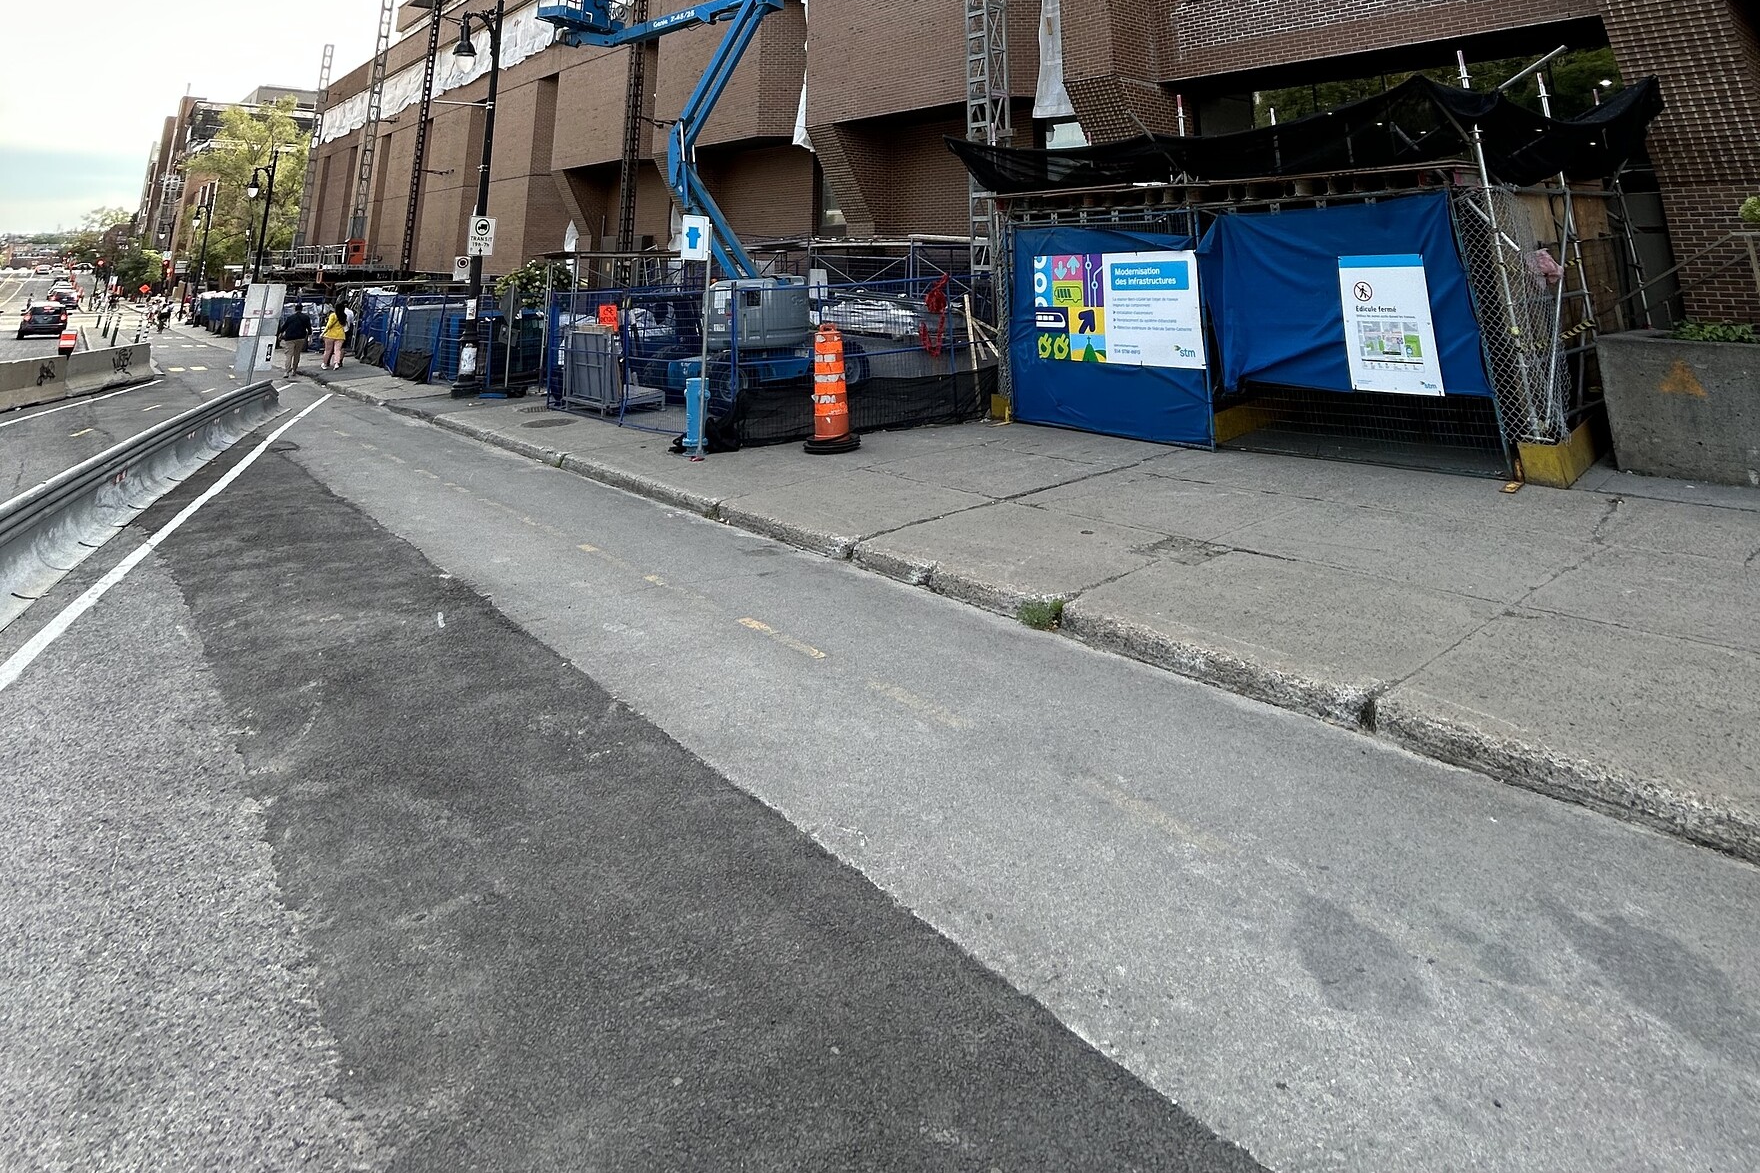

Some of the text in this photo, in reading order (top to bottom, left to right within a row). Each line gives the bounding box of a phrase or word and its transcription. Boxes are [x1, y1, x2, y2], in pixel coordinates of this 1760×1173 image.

[1114, 267, 1160, 276] Modernisation
[1128, 277, 1177, 285] infrastructures
[1378, 305, 1397, 313] fermé
[1179, 348, 1196, 358] stm
